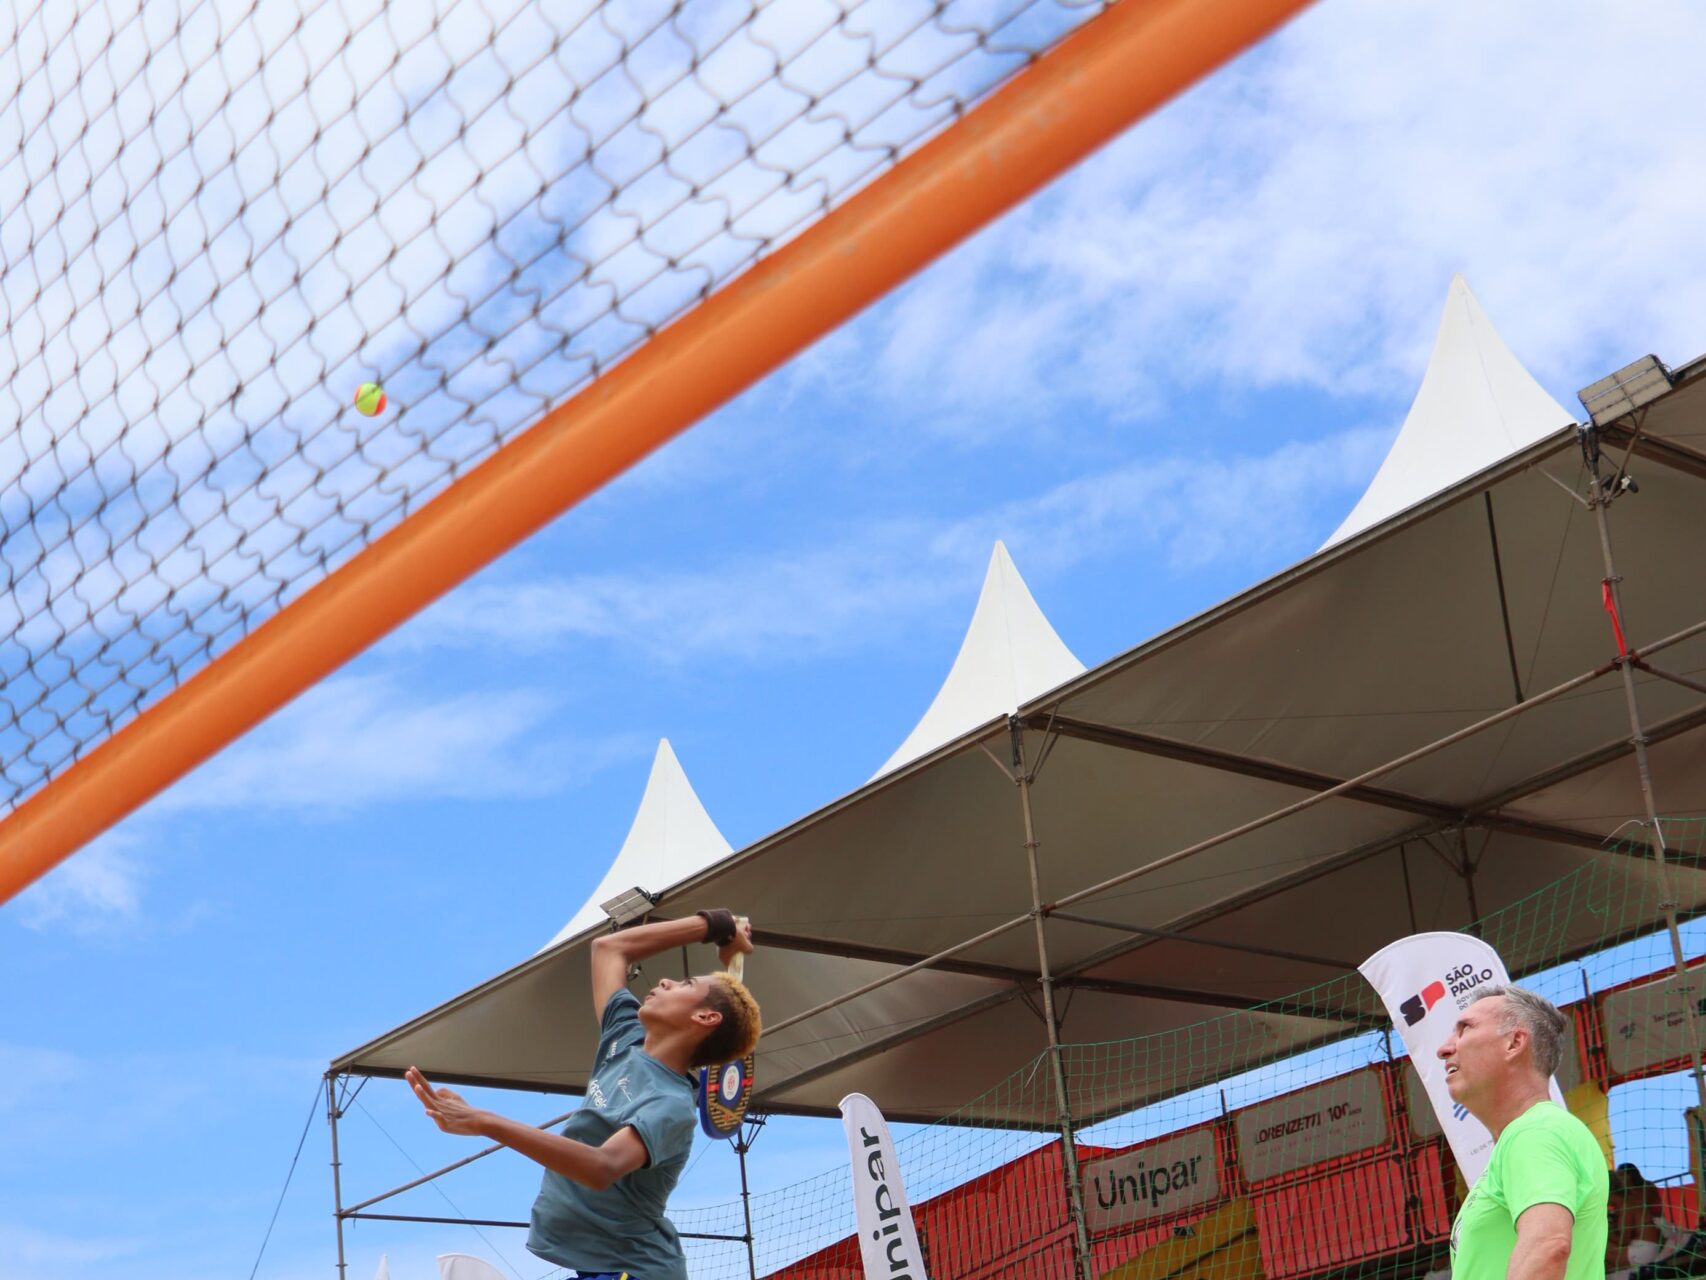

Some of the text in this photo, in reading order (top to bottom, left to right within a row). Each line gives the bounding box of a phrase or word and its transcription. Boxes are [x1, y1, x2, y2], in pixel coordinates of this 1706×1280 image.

[1445, 963, 1473, 985] SÃO
[1450, 968, 1493, 997] PAULO
[1256, 1111, 1321, 1145] LORENZETTI
[1094, 1155, 1202, 1210] Unipar
